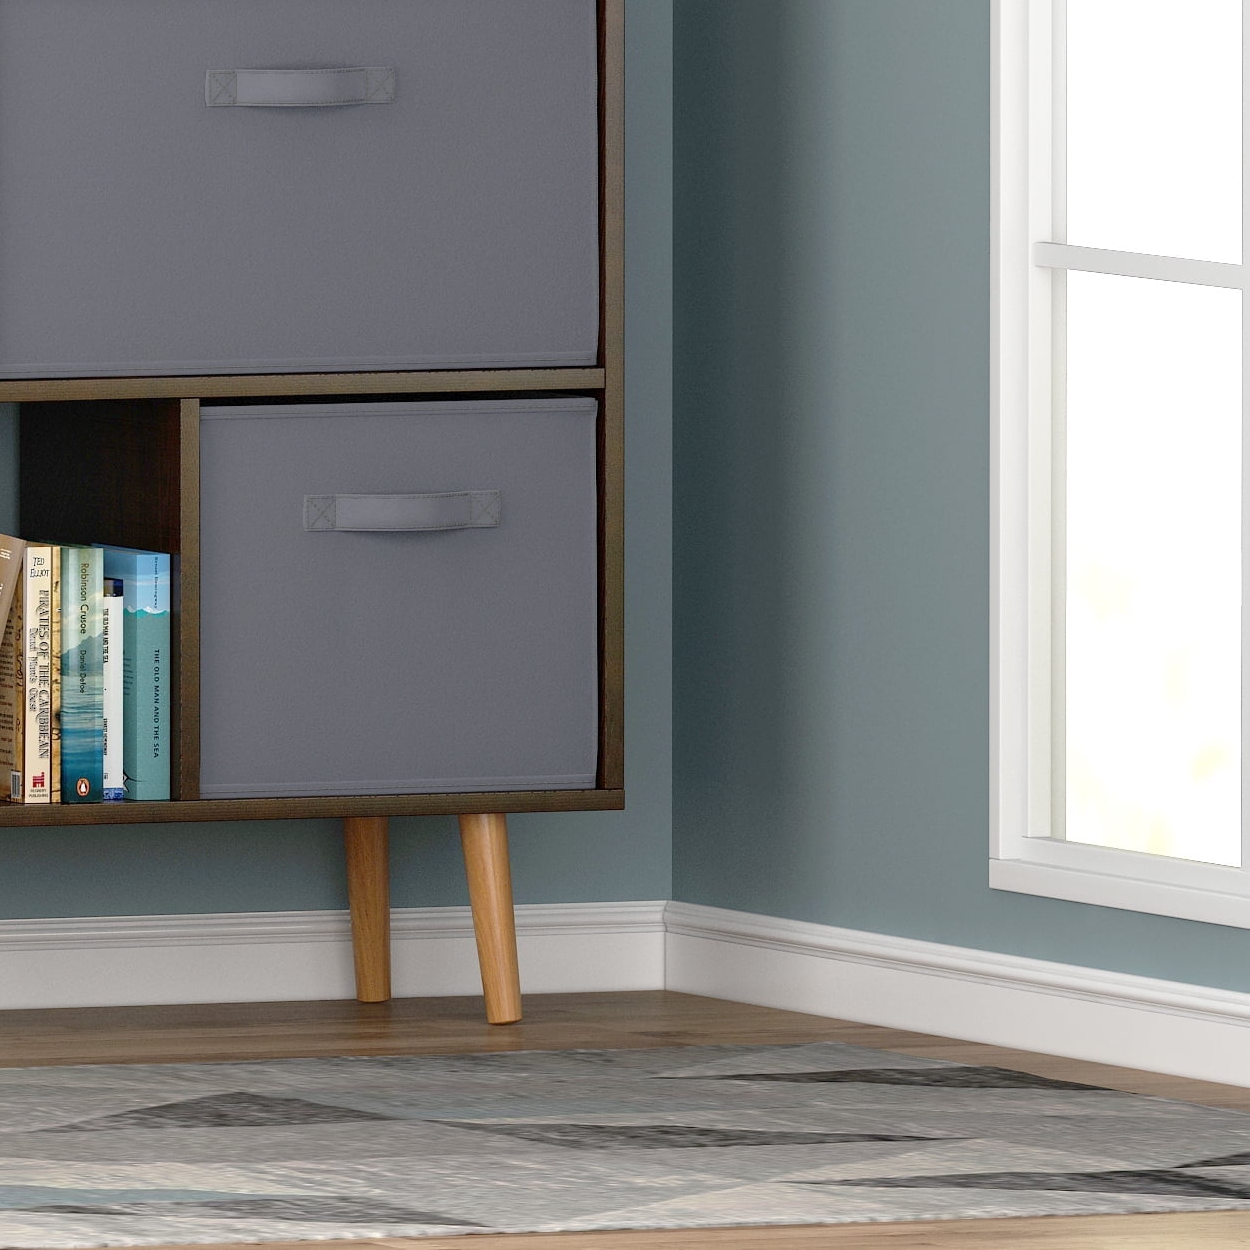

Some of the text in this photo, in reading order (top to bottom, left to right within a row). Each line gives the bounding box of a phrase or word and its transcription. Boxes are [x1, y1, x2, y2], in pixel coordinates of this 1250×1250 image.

[33, 557, 45, 567] TED
[80, 563, 90, 634] Robinson Crusoe
[36, 590, 49, 759] PIRATES OF THE CARIBBEAN
[79, 650, 87, 693] Daniel Defoe
